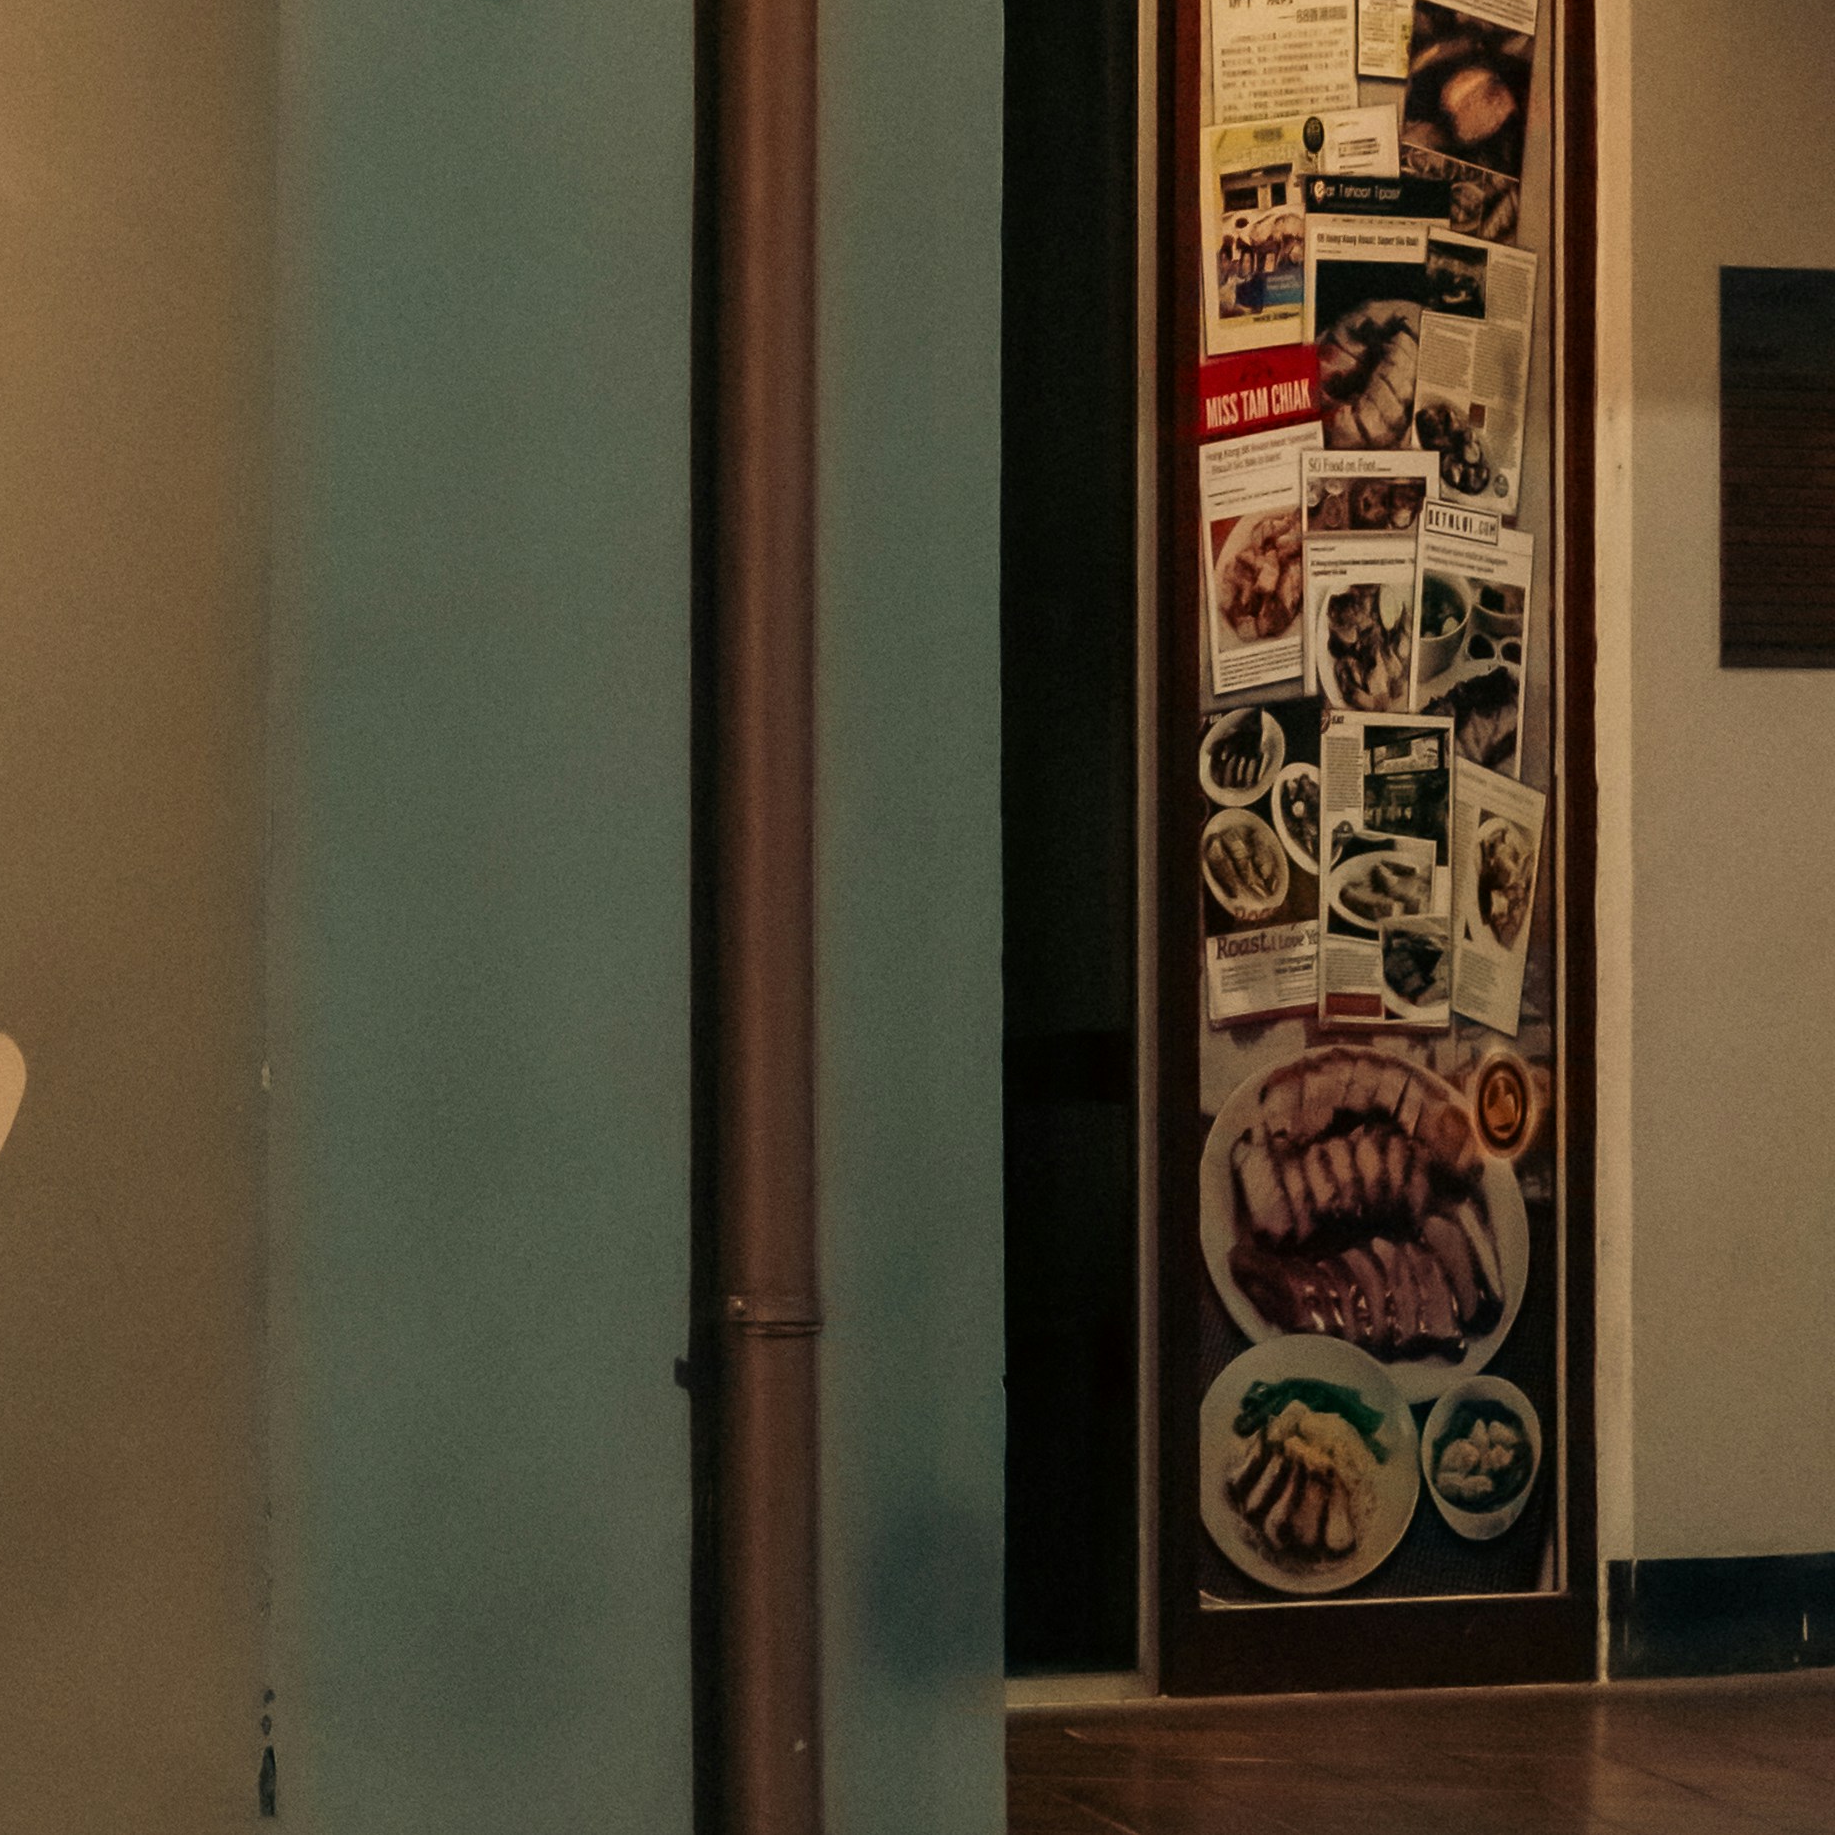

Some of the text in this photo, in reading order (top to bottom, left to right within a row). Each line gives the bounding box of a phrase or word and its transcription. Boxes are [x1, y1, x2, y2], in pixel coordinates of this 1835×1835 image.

[1205, 378, 1311, 430] MISS TAM CHIAK
